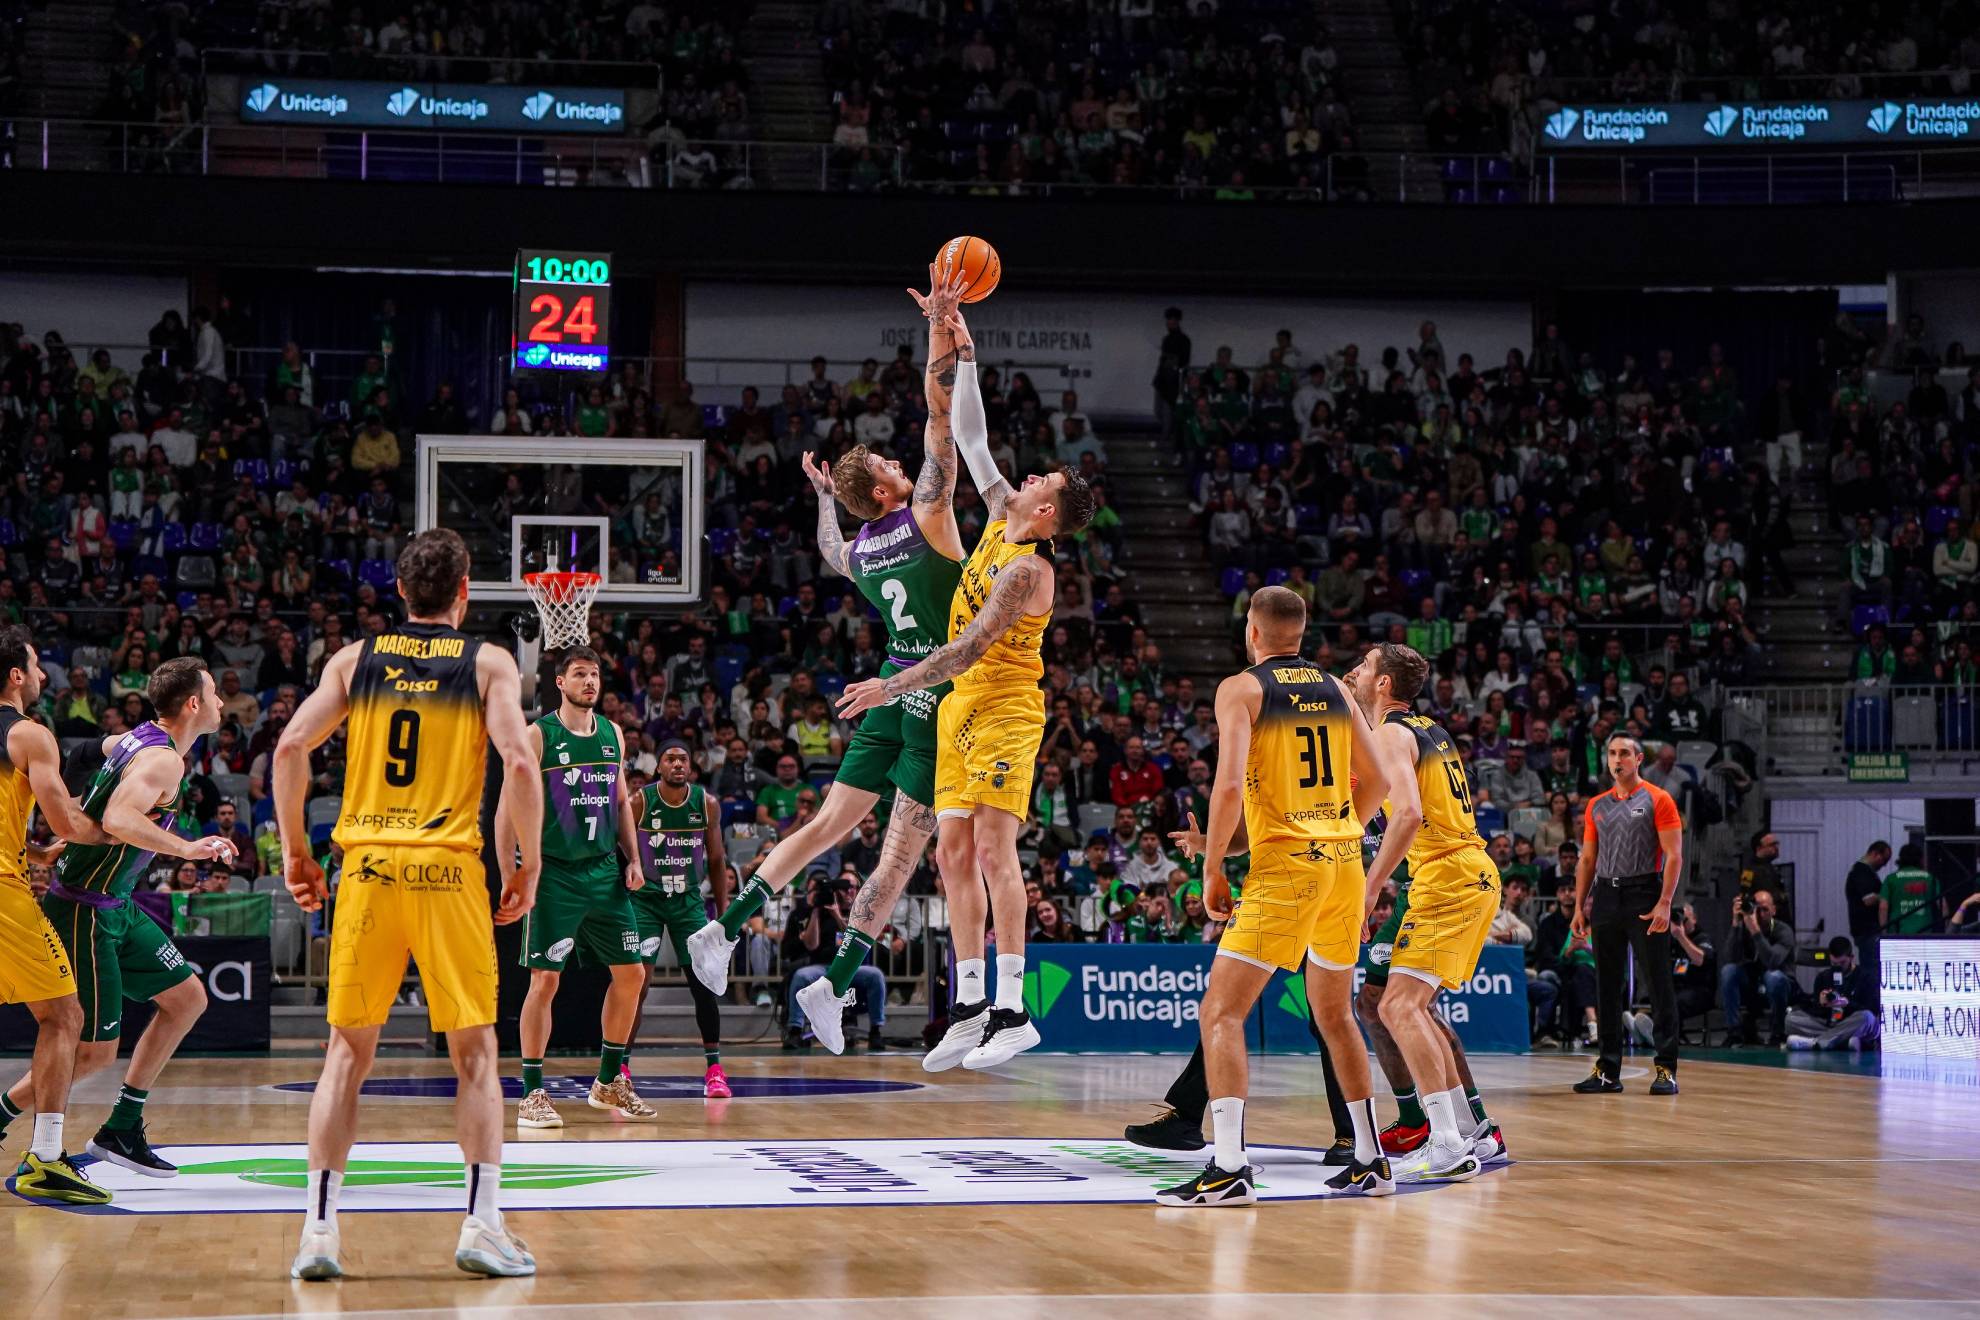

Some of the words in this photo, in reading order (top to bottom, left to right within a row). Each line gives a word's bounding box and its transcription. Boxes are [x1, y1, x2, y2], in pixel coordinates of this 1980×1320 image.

[281, 94, 348, 116] Unicaja
[420, 98, 488, 121] Unicaja
[556, 102, 622, 125] Unicaja
[1743, 106, 1829, 123] Fundación
[1906, 102, 1980, 121] Fundació
[1583, 107, 1668, 125] Fundación
[1583, 123, 1646, 144] Unicaja
[1743, 120, 1805, 141] Unicaja
[1906, 118, 1968, 139] Unicaja
[528, 257, 609, 284] 10:00
[529, 294, 599, 344] 24
[1016, 331, 1092, 351] CARPENA
[551, 352, 602, 370] Unicaja
[647, 568, 662, 578] liga
[647, 575, 677, 583] endesa
[881, 579, 918, 631] 2
[374, 635, 465, 659] MARCELINHO
[1273, 668, 1324, 684] GIEDRAITIS
[385, 709, 420, 787] 9
[1296, 725, 1334, 789] 31
[583, 771, 616, 784] Unicaja
[344, 814, 417, 830] EXPRESS
[1284, 808, 1337, 823] EXPRESS
[585, 816, 598, 841] 7
[667, 836, 702, 849] Unicaja
[403, 864, 463, 884] CICAR
[661, 875, 686, 894] 55
[1082, 964, 1211, 992] Fundaci
[1083, 993, 1200, 1029] Unicaja
[1893, 1004, 1939, 1037] MARIA,
[1945, 1007, 1980, 1037] RON
